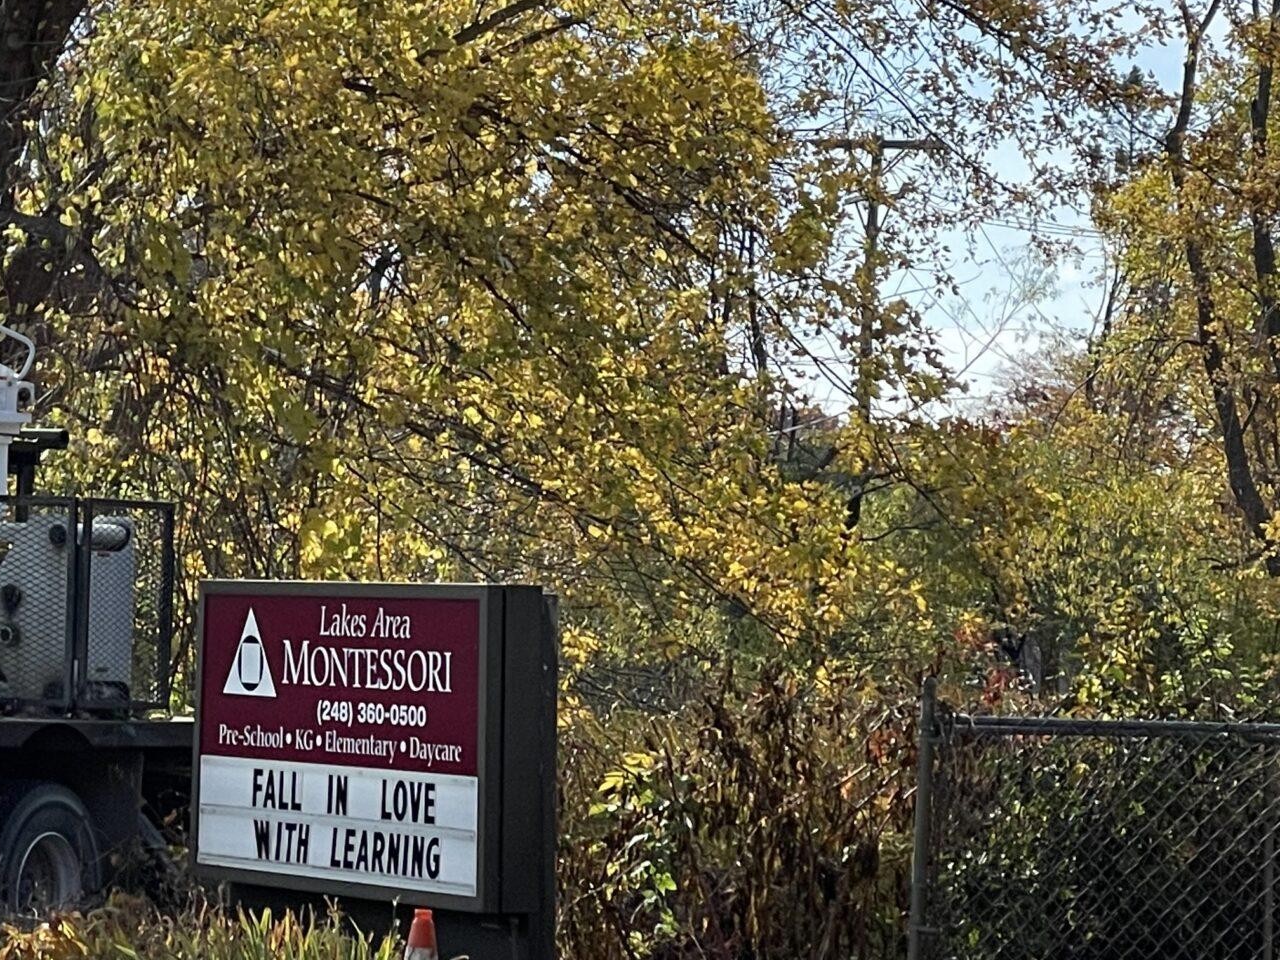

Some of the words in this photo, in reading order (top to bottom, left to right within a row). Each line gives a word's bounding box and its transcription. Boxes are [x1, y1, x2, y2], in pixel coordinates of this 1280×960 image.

[319, 603, 366, 638] Lakes
[371, 607, 411, 639] Area
[281, 639, 452, 694] MONTESSORI
[317, 699, 354, 727] (248)
[357, 701, 427, 727] 360-0500
[219, 723, 284, 749] Pre-School
[295, 729, 314, 751] KG
[325, 730, 398, 764] Elementary
[409, 736, 462, 767] Daycare
[252, 768, 302, 811] FALL
[326, 774, 348, 816] IN
[381, 779, 435, 824] LOVE
[253, 819, 310, 864] WITH
[330, 827, 440, 880] LEARNING
